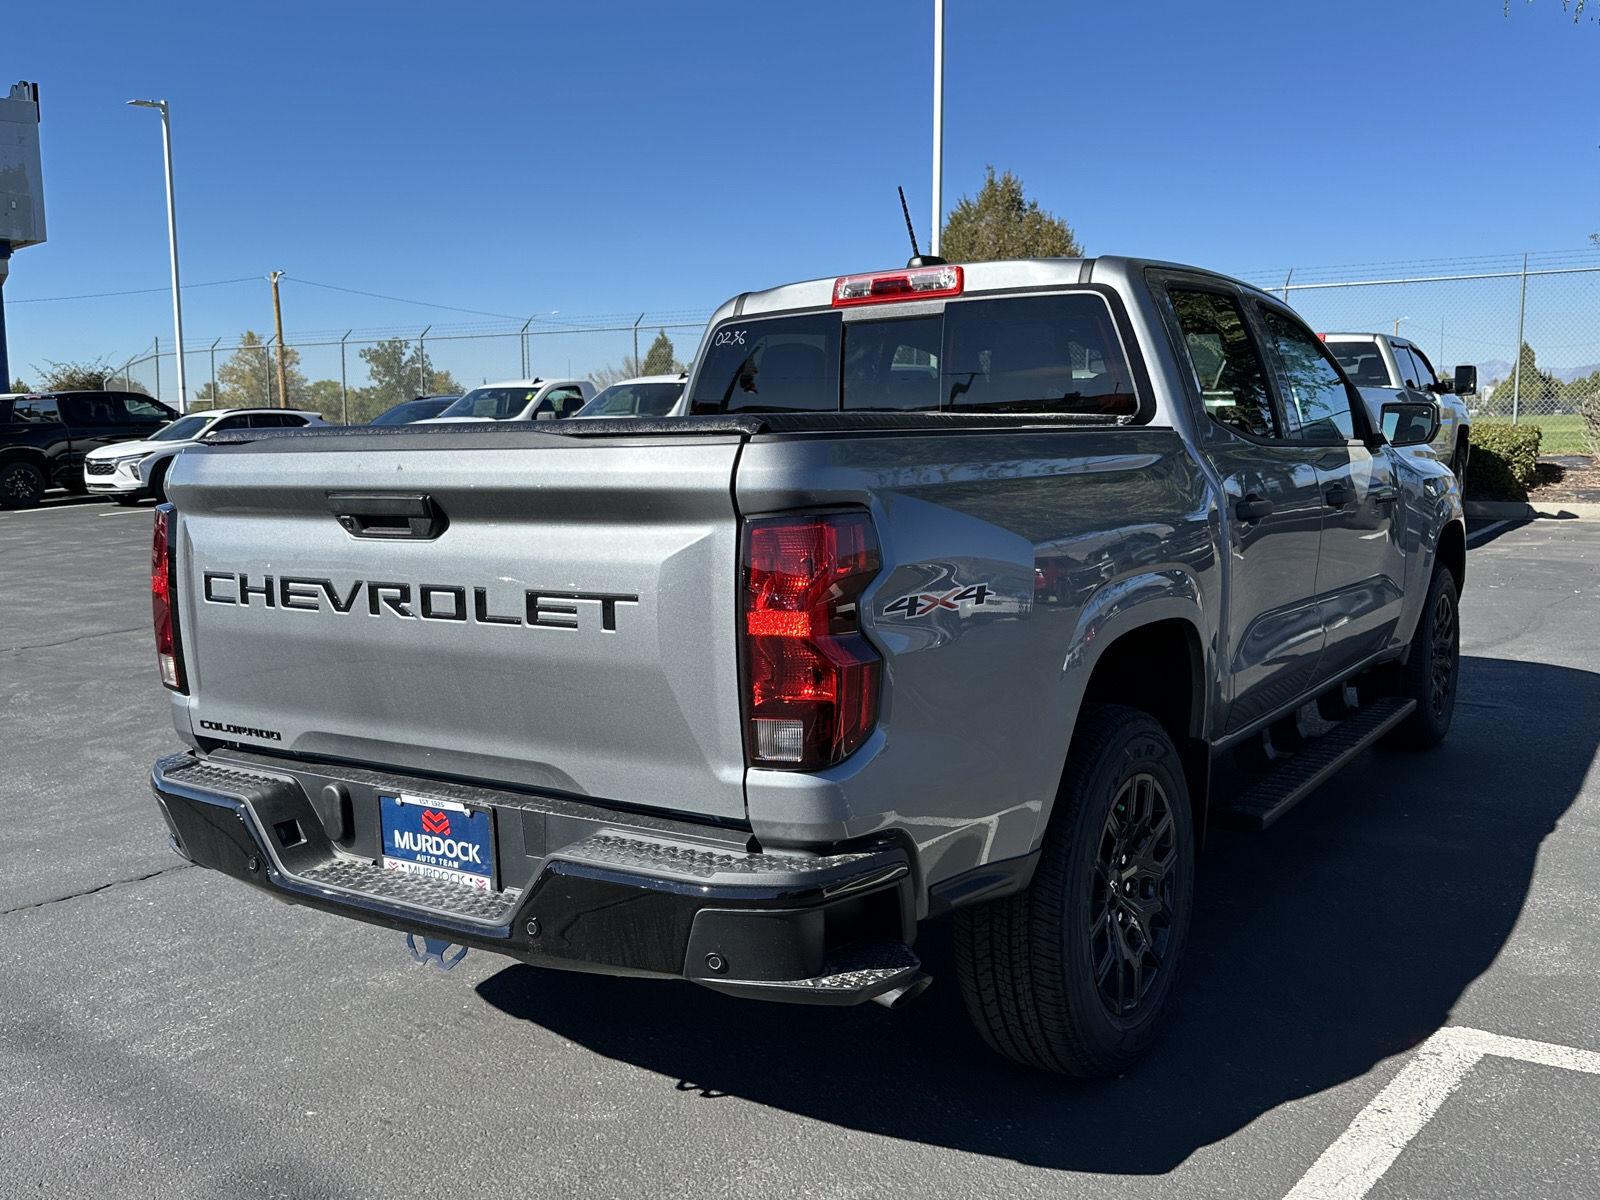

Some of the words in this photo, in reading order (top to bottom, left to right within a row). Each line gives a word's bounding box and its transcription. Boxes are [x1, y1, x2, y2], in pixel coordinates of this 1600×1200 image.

[715, 330, 747, 346] 0236
[203, 570, 639, 633] CHEVROLET
[200, 720, 281, 741] COLORADO
[394, 829, 481, 864] MURDOCK
[416, 853, 436, 864] AUTO
[439, 857, 459, 869] TEAM
[407, 864, 465, 885] MURDOCK
